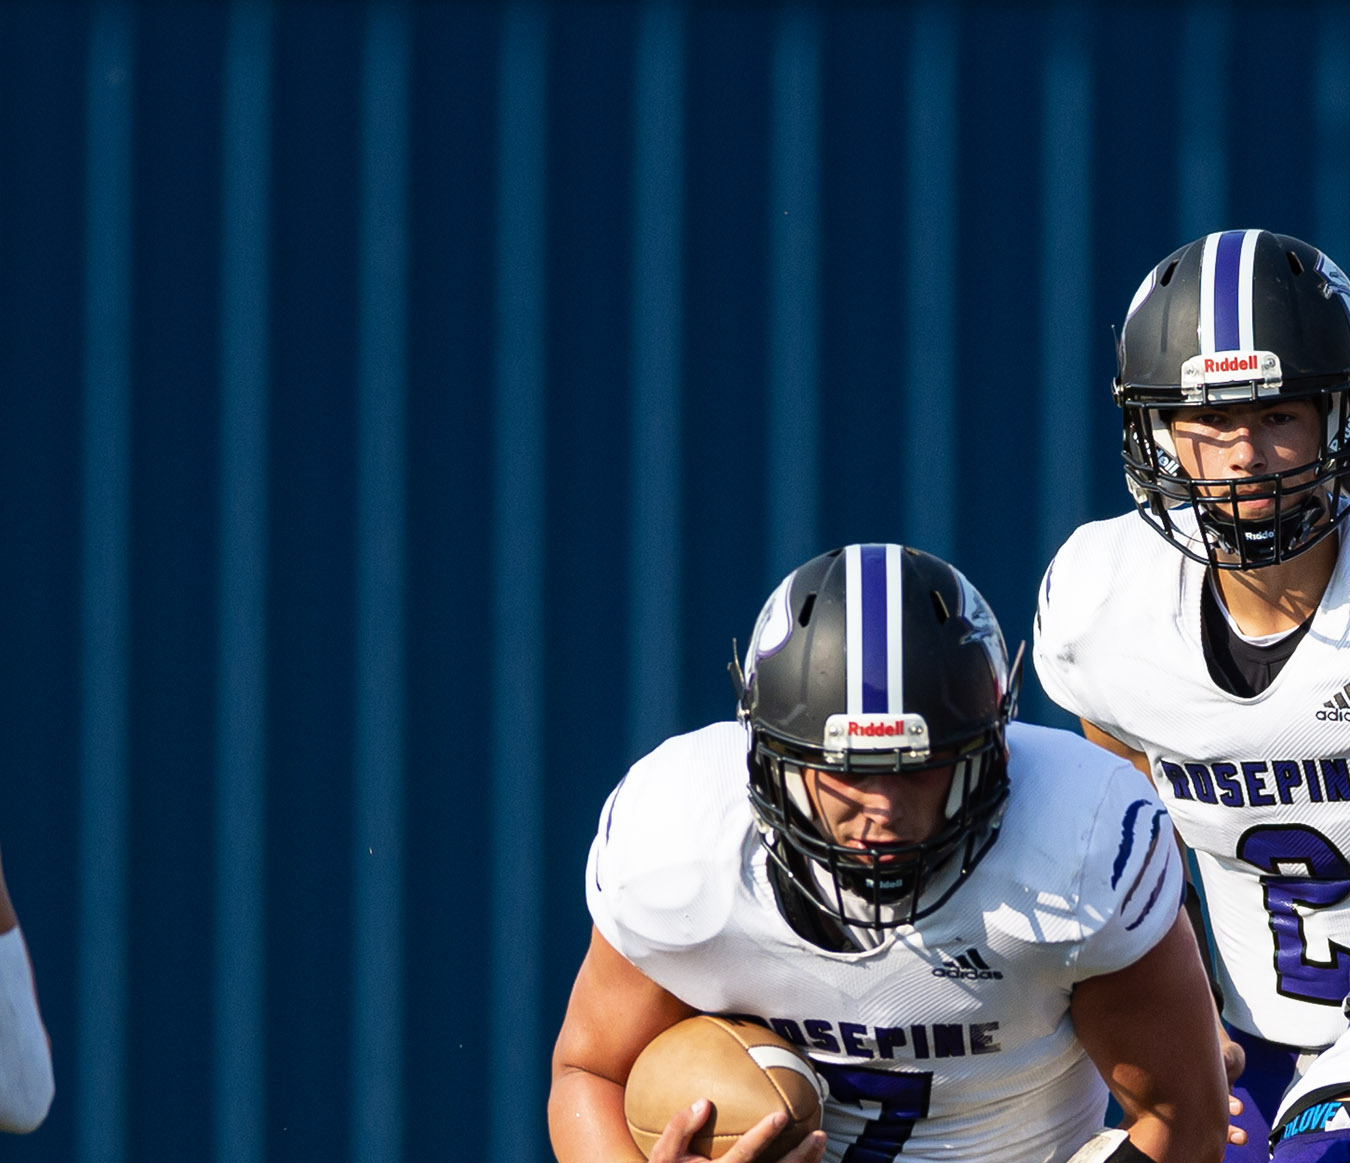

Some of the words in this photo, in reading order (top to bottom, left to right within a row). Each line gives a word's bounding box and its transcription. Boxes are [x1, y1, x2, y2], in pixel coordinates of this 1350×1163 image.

[1204, 355, 1258, 373] Riddell
[847, 720, 905, 737] Riddell
[932, 968, 1003, 981] adidas
[717, 1012, 1001, 1060] OSEPINE
